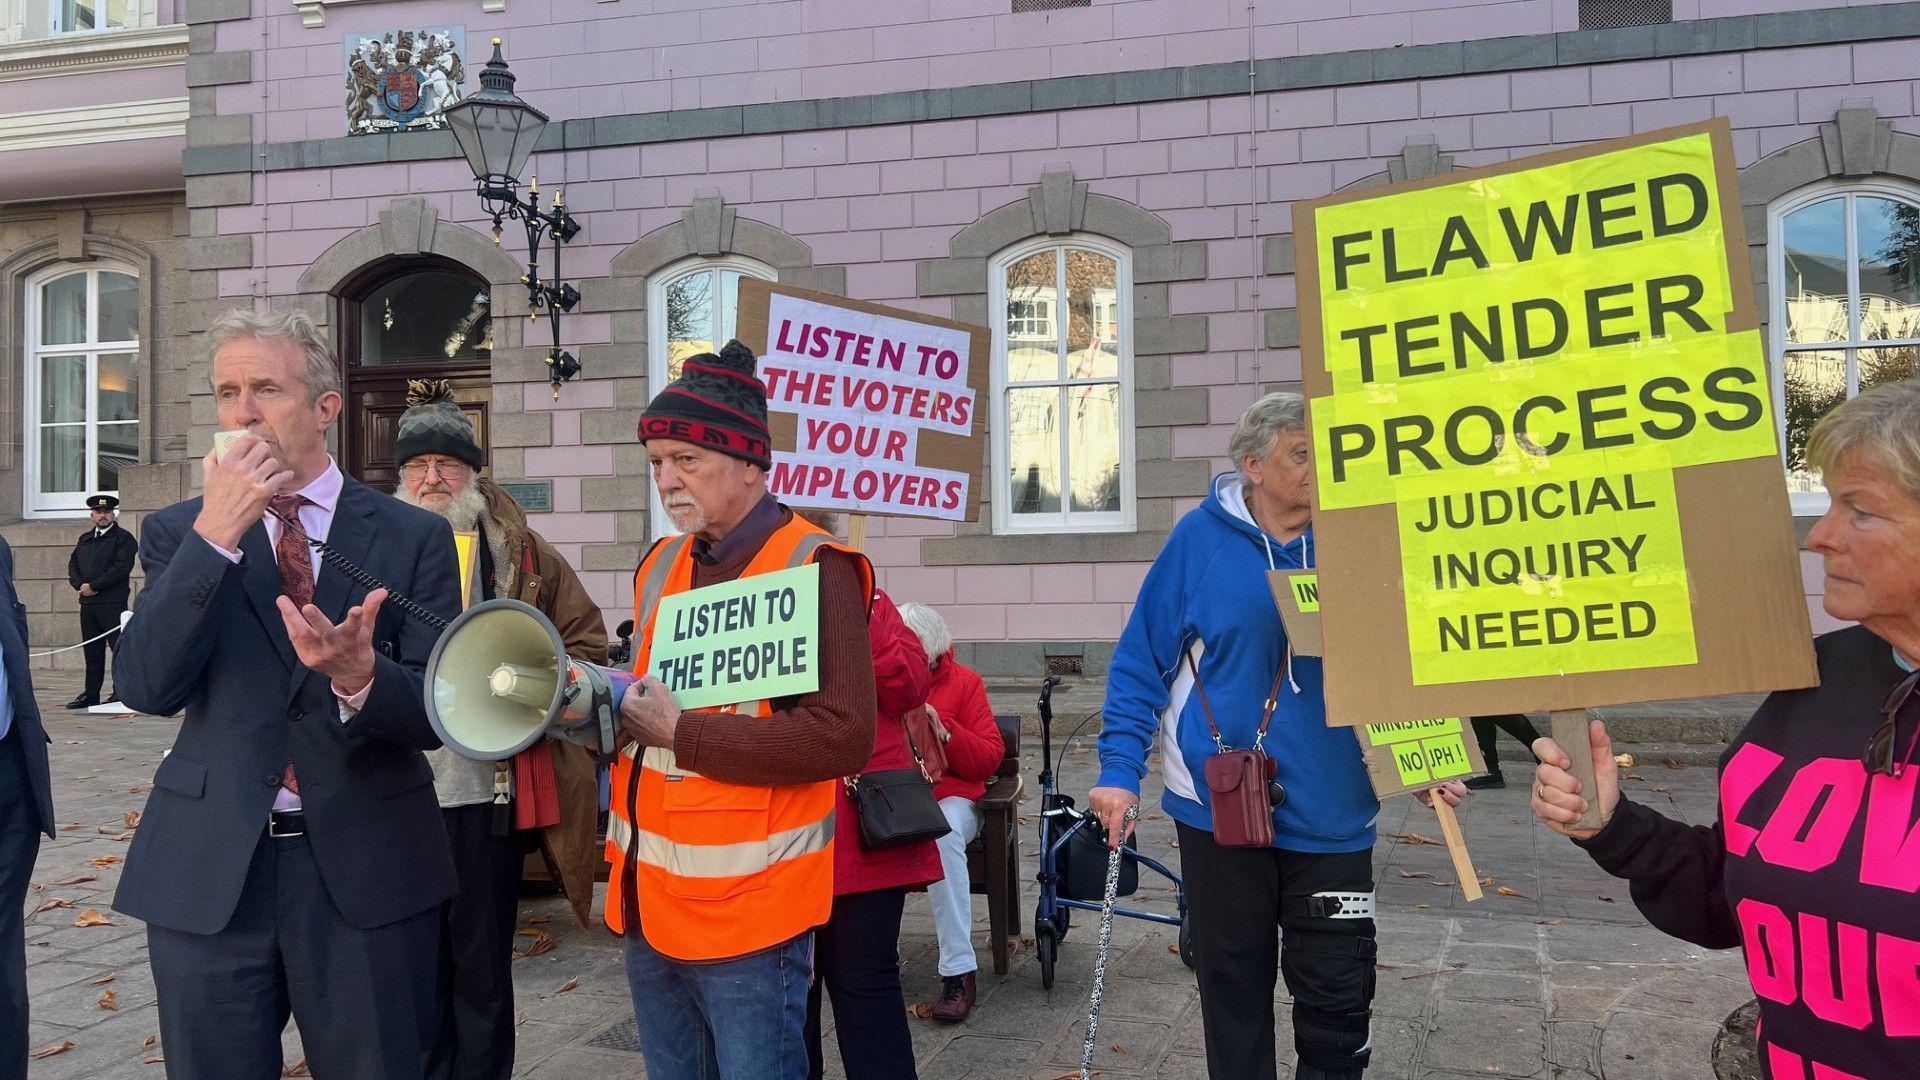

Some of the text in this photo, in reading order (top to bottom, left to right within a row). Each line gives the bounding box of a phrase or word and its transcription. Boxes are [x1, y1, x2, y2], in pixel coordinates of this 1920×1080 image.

[1332, 172, 1709, 291] FLAWED
[775, 319, 959, 380] LISTEN TO
[1340, 274, 1713, 383] TENDER
[762, 366, 972, 426] THE VOTERS
[805, 418, 908, 462] YOUR
[1328, 366, 1764, 483] PROCESS
[764, 462, 963, 510] MPLOYERS
[1415, 474, 1656, 532] JUDICIAL
[1432, 534, 1648, 590] INQUIRY
[673, 587, 796, 642] LISTEN TO
[1438, 600, 1657, 652] NEEDED
[658, 636, 807, 692] THE PEOPLE
[1399, 751, 1424, 772] NO
